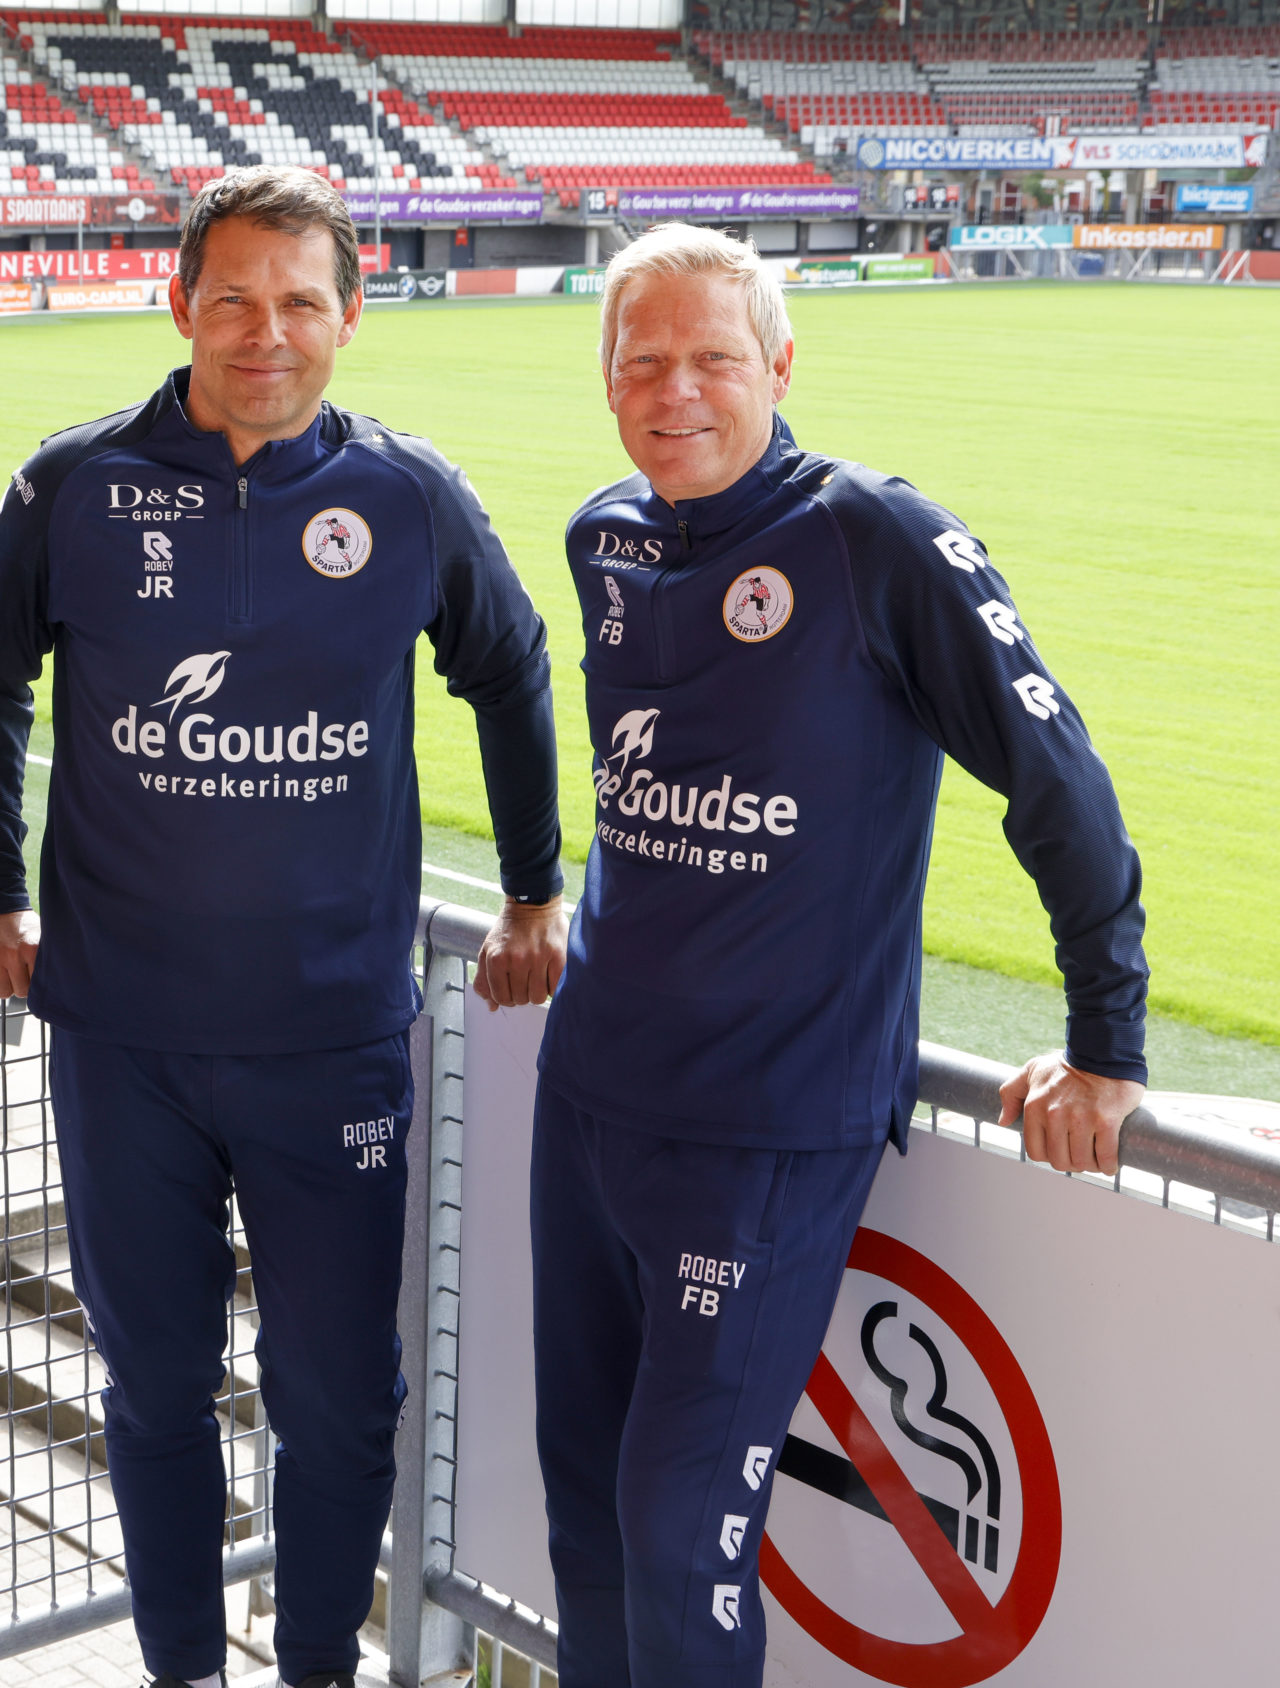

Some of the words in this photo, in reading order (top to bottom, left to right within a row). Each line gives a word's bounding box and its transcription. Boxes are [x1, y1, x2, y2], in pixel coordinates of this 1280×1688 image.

[1083, 145, 1111, 160] VLS
[434, 199, 470, 213] Goudse
[960, 226, 1044, 248] LOGIX
[1080, 226, 1213, 247] Inkassier.nl
[0, 252, 109, 278] NEVILLE
[106, 484, 205, 509] D&S
[132, 510, 182, 521] GROEP
[593, 530, 663, 563] D&S
[144, 560, 174, 572] ROBEY
[312, 554, 347, 573] SPARTA
[601, 558, 638, 570] GROEP
[136, 575, 175, 599] JR
[598, 618, 624, 646] FB
[729, 616, 761, 637] SPARTA
[111, 705, 166, 759] de
[179, 710, 369, 763] Goudse
[138, 771, 349, 802] verzekeringen
[618, 768, 799, 837] Goudse
[596, 819, 769, 874] verzekeringen
[343, 1115, 395, 1148] ROBEY
[355, 1145, 388, 1170] JR
[677, 1252, 747, 1289] ROBEY
[680, 1284, 721, 1317] FB
